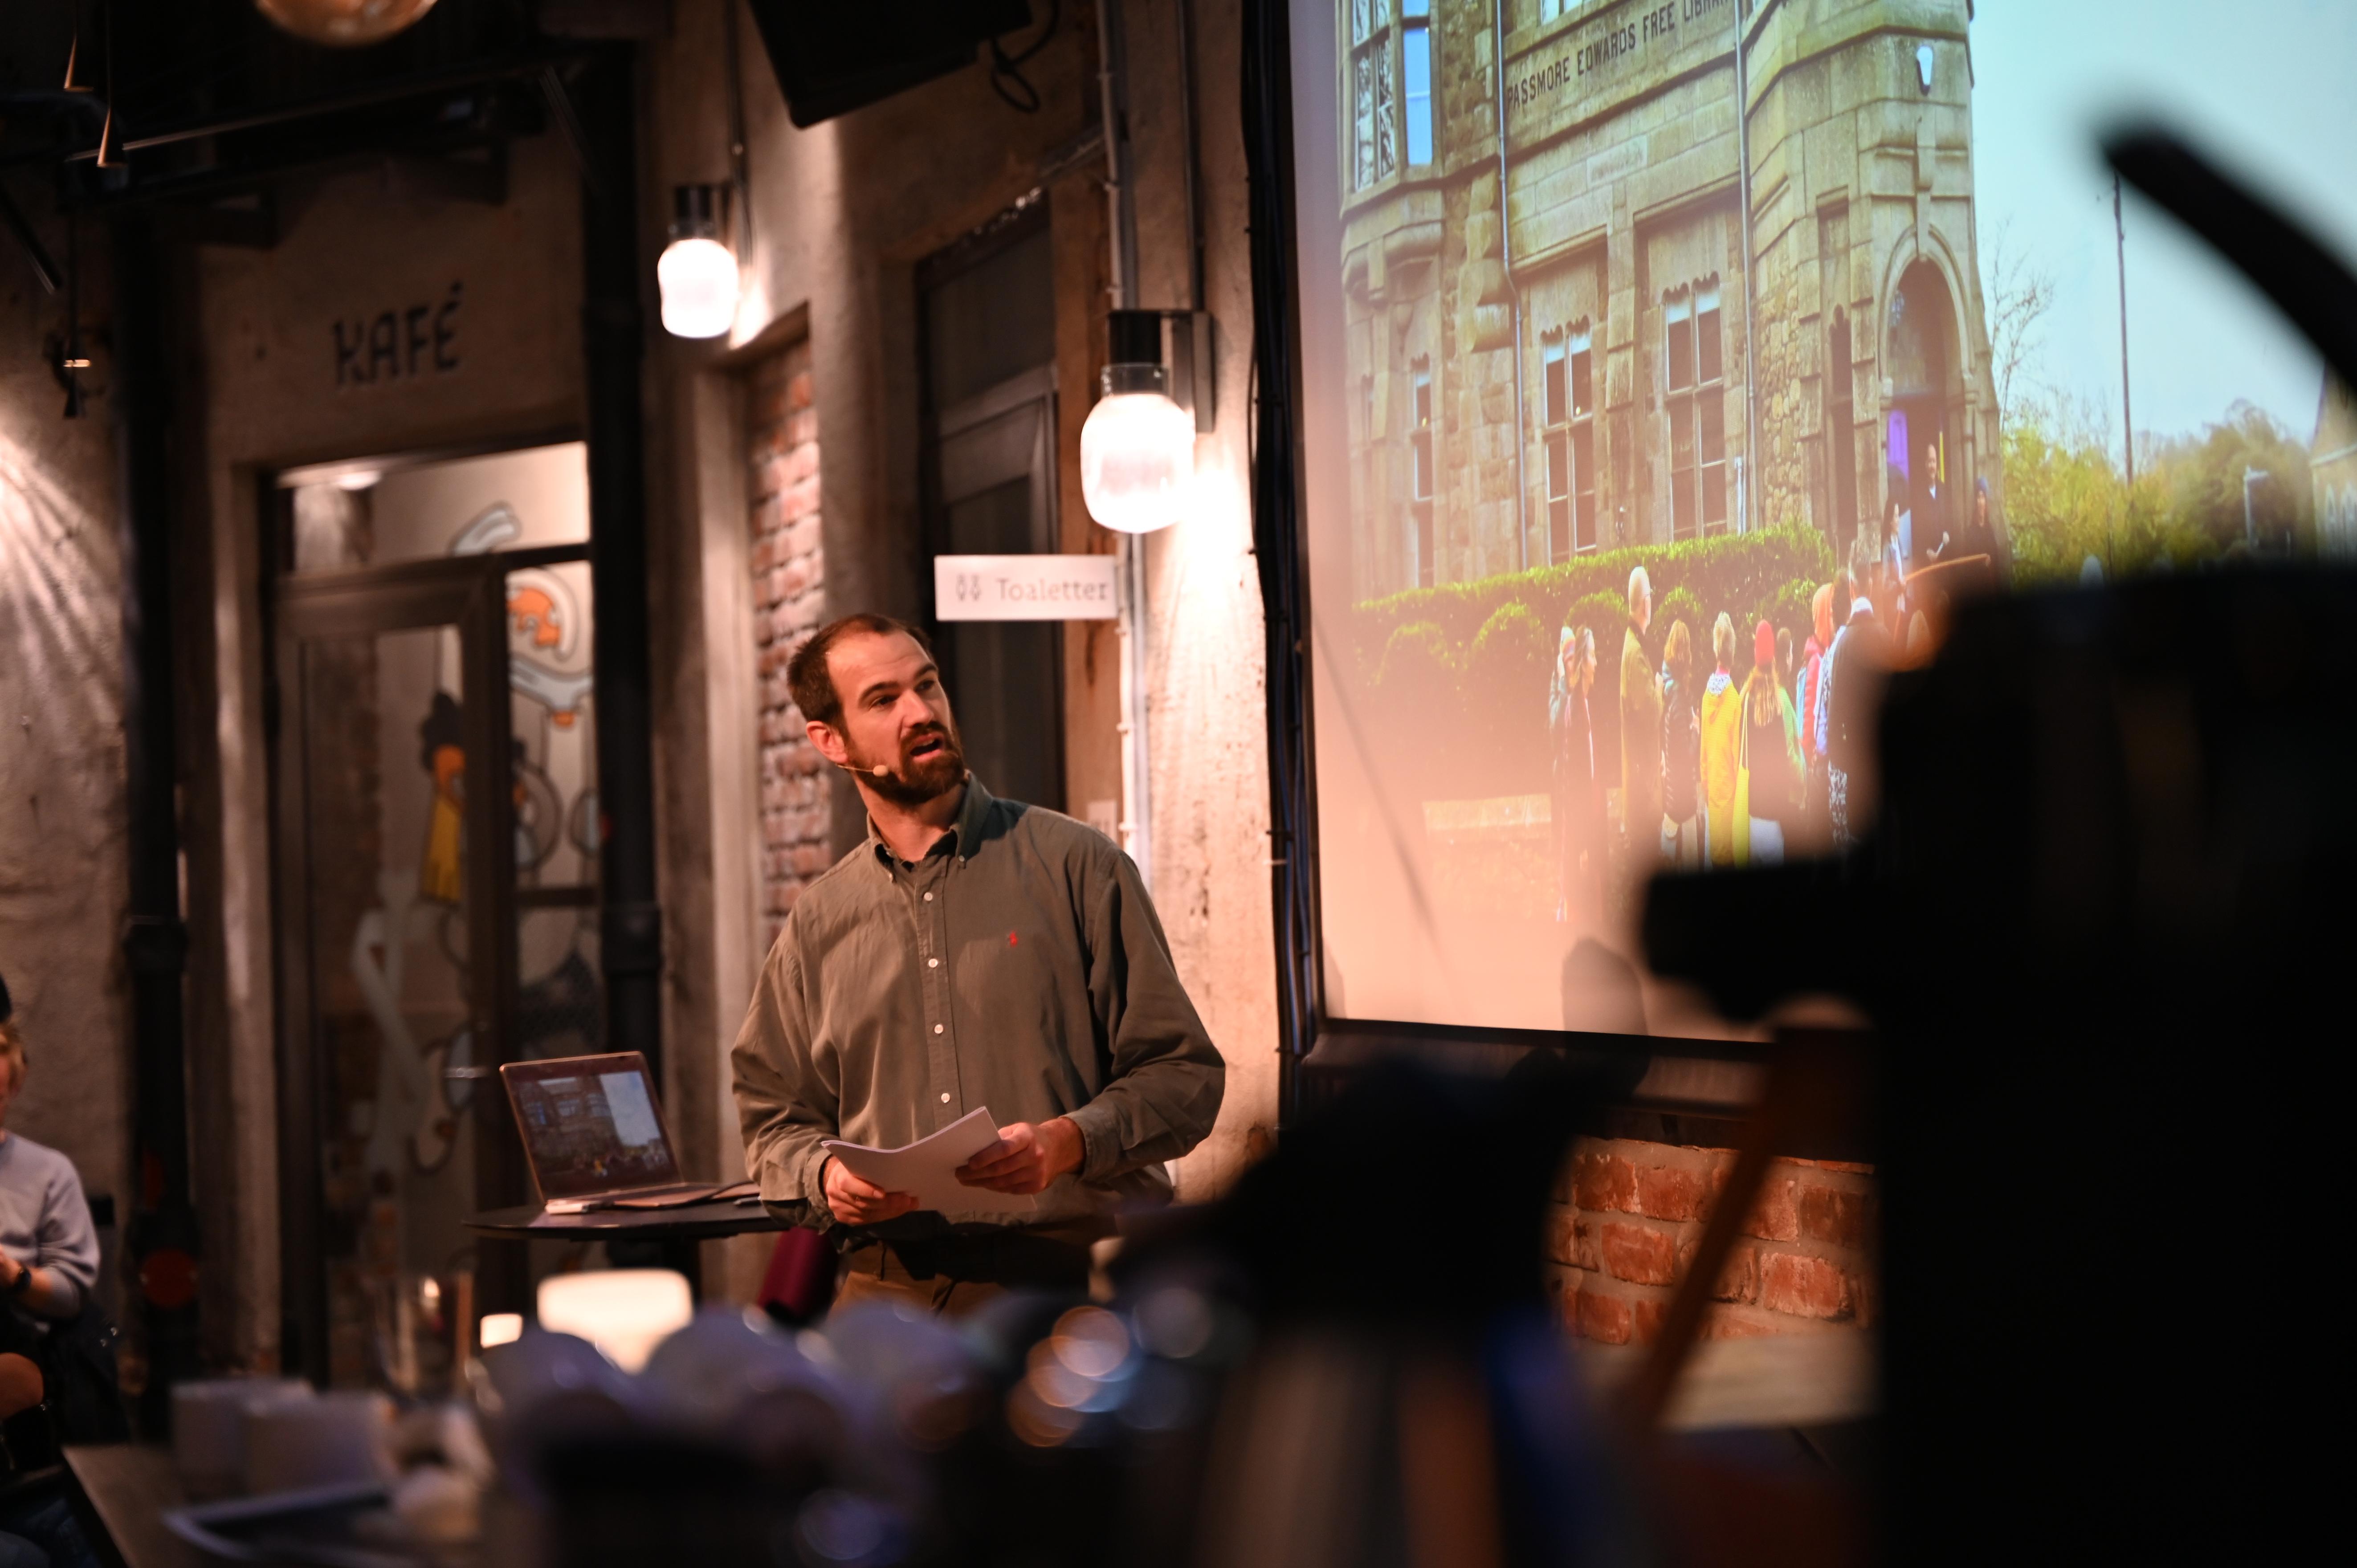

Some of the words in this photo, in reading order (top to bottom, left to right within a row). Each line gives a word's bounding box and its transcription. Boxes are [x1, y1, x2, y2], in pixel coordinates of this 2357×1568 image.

[1507, 57, 1570, 110] PASSMORE
[1577, 23, 1635, 76] EDWARDS
[1643, 2, 1675, 42] FREE
[333, 281, 463, 384] KAFÉ
[996, 578, 1109, 601] Toaletter
